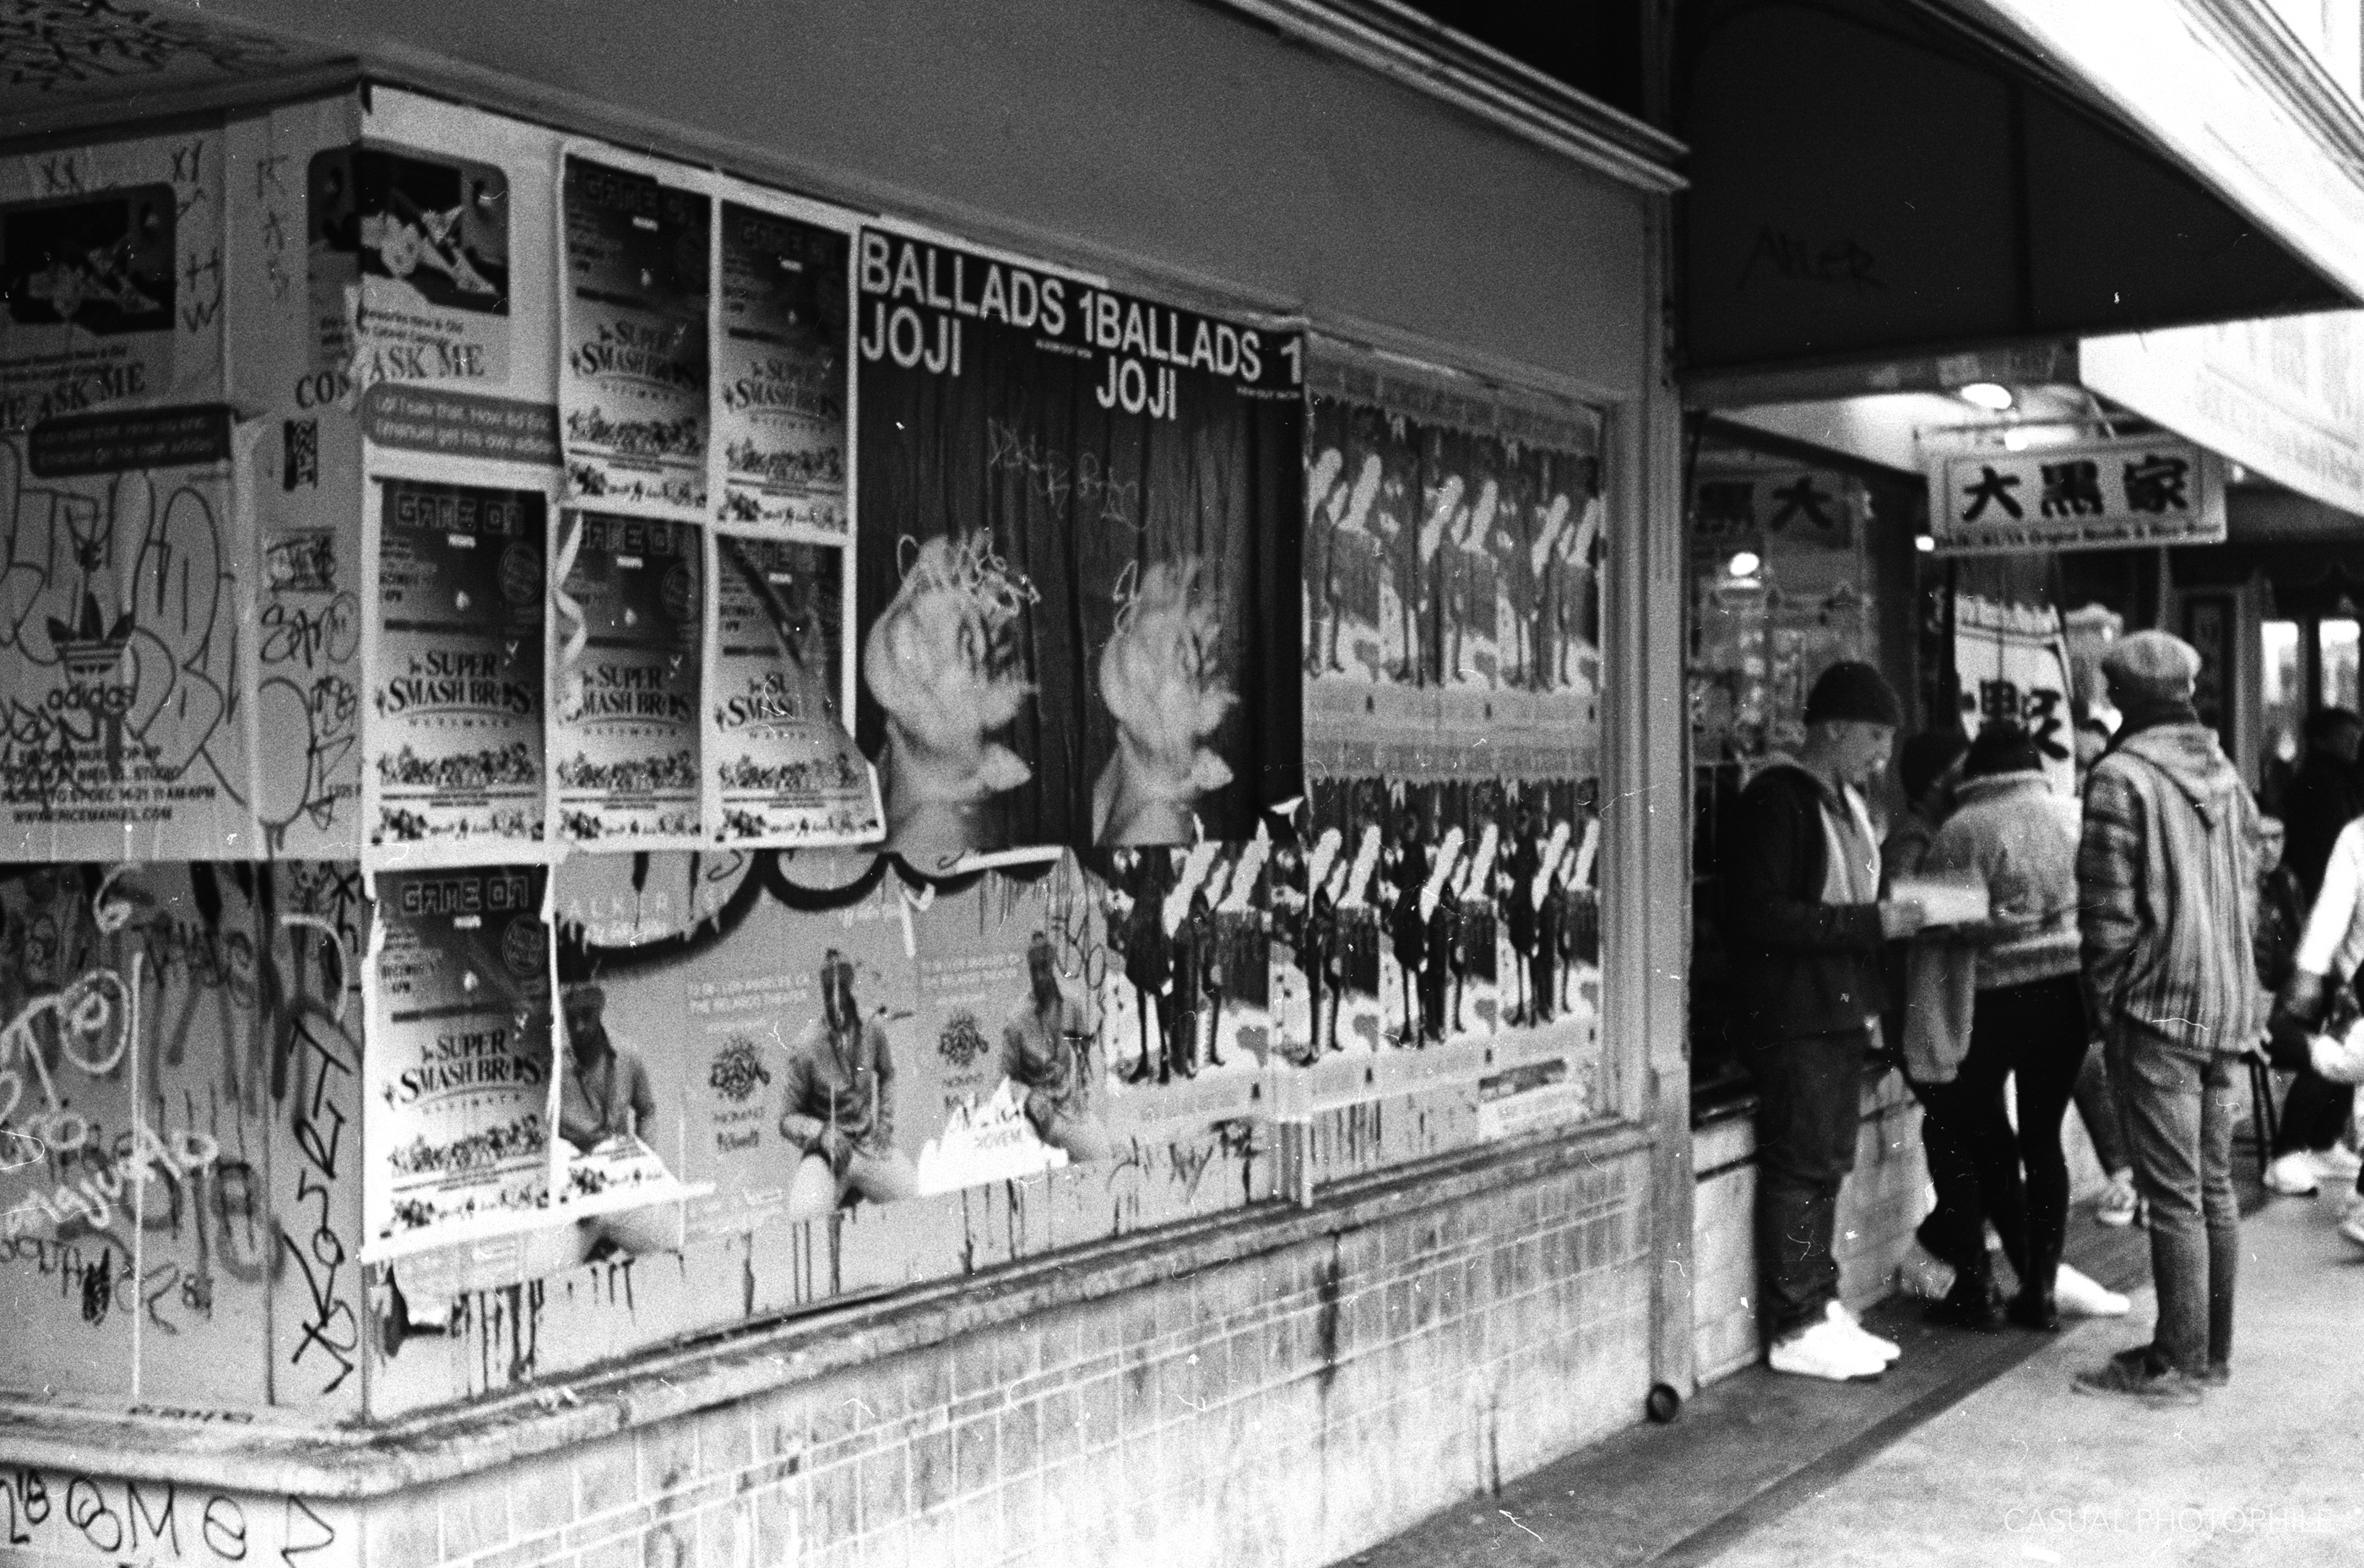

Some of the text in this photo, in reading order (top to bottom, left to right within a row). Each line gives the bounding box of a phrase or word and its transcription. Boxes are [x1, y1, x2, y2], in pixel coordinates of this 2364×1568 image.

[859, 233, 1095, 343] BALLADS 1
[859, 301, 962, 377] JOJI
[1098, 293, 1303, 384] BALLADS 1
[370, 341, 487, 382] ASK ME
[1096, 355, 1176, 421] JOJI
[426, 650, 497, 678] SUPER
[388, 677, 464, 712] SMASH
[400, 874, 530, 915] GAME ON
[436, 1029, 508, 1061] SUPER
[400, 1061, 473, 1104] SMASH
